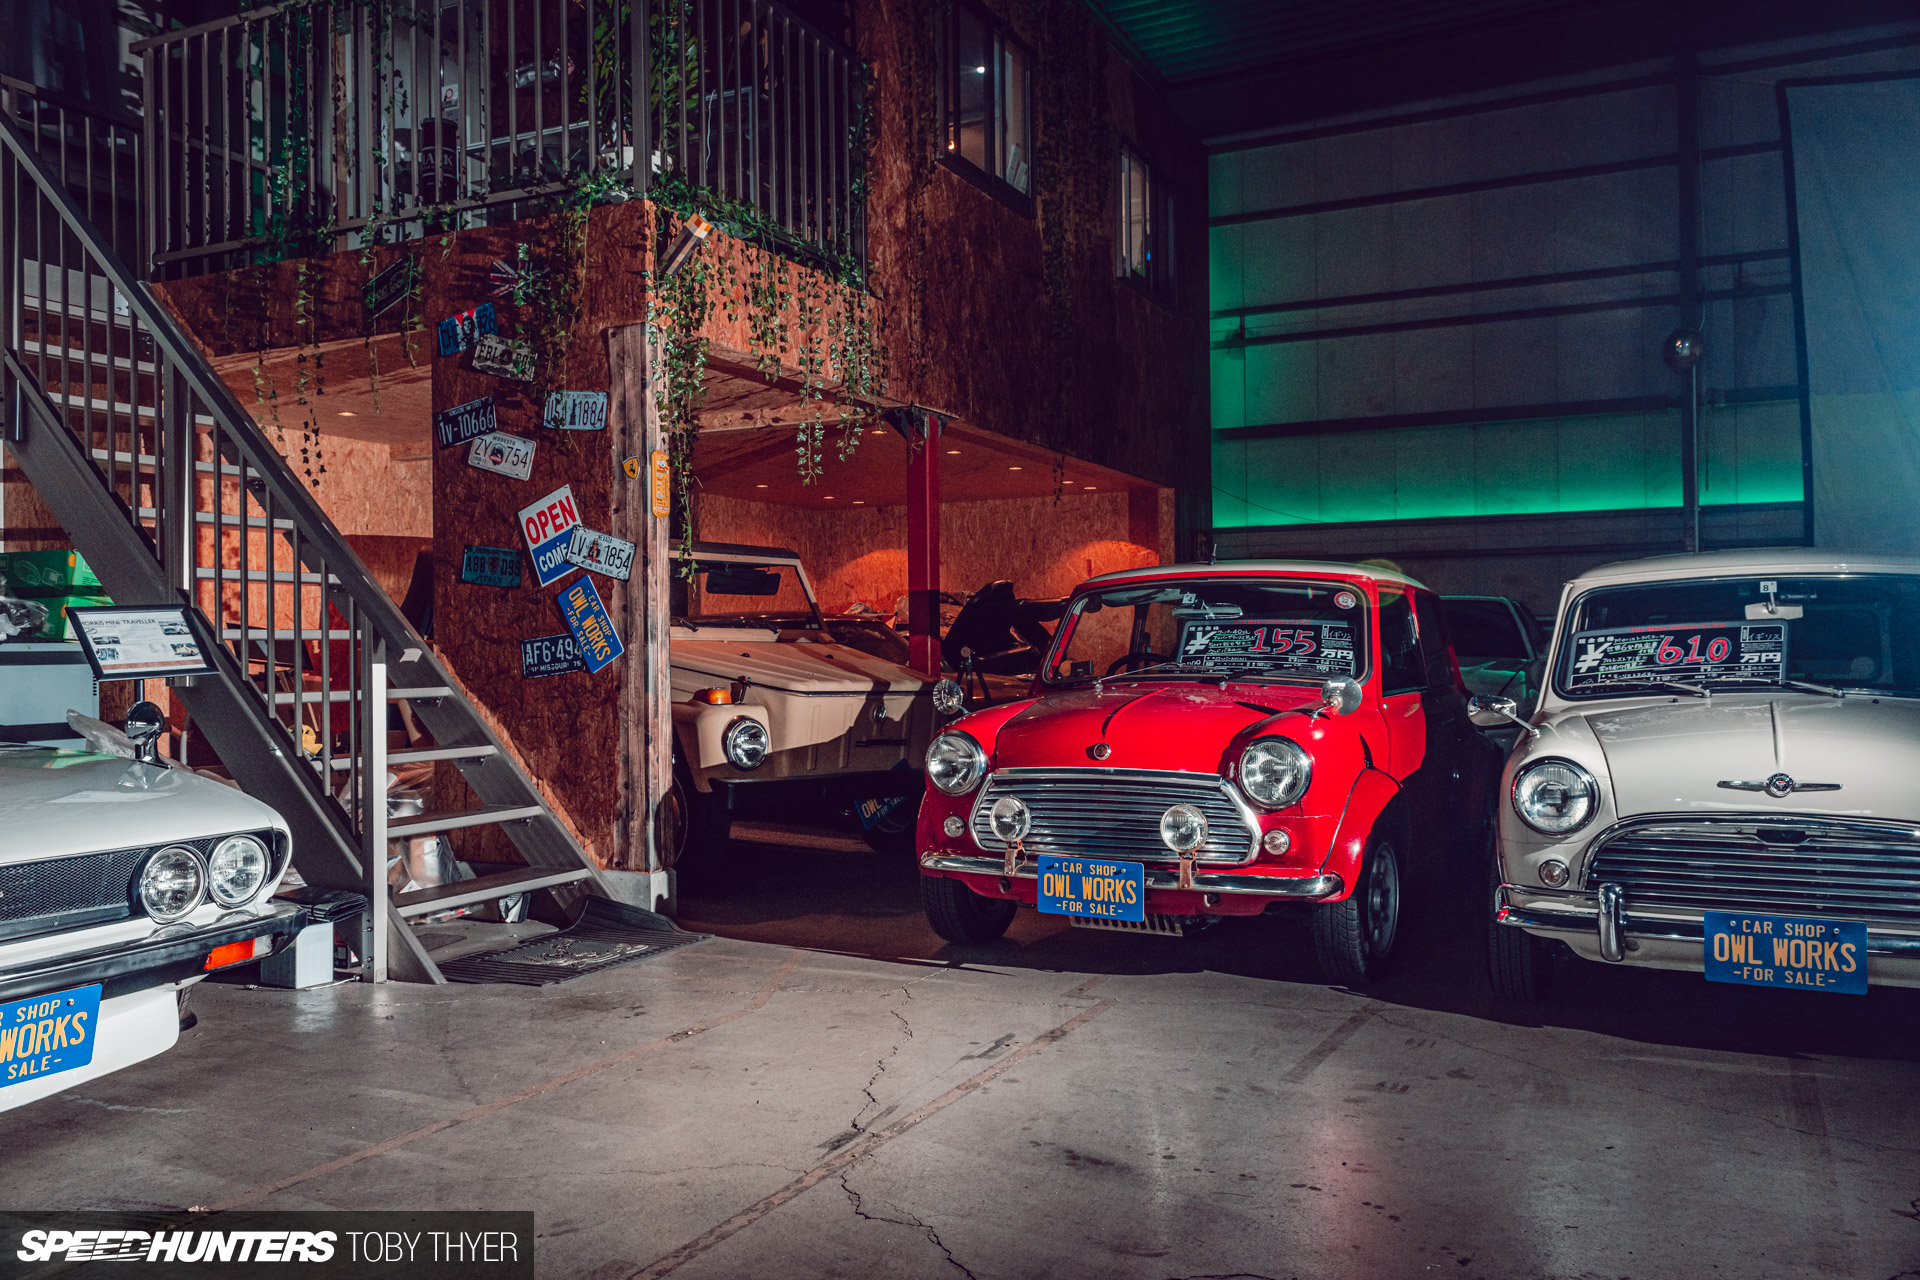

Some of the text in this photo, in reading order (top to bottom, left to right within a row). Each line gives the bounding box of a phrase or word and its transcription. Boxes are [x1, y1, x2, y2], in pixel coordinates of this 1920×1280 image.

[578, 400, 605, 427] 1884
[474, 437, 529, 469] ZY 754
[492, 435, 516, 446] MODESTO
[525, 495, 577, 545] OPEN
[570, 533, 632, 572] LV 1854
[598, 534, 613, 543] NEVADA
[1763, 584, 1769, 592] 8
[568, 586, 611, 661] OWL WORKS
[588, 594, 612, 637] CAR SHOP
[1248, 627, 1316, 655] 155
[1320, 648, 1354, 660] 万円
[1578, 636, 1615, 645] 現金価格
[1654, 634, 1732, 665] 610
[1740, 652, 1782, 663] 万円
[1748, 632, 1781, 641] イギリス
[861, 797, 882, 819] OWL
[1062, 862, 1117, 876] CAR SHOP
[1044, 873, 1137, 904] OWL WORKS
[1743, 920, 1826, 938] CAR SHOP
[1714, 933, 1857, 973] OWL WORKS
[16, 1000, 60, 1023] SHOP
[0, 1012, 88, 1064] WORKS
